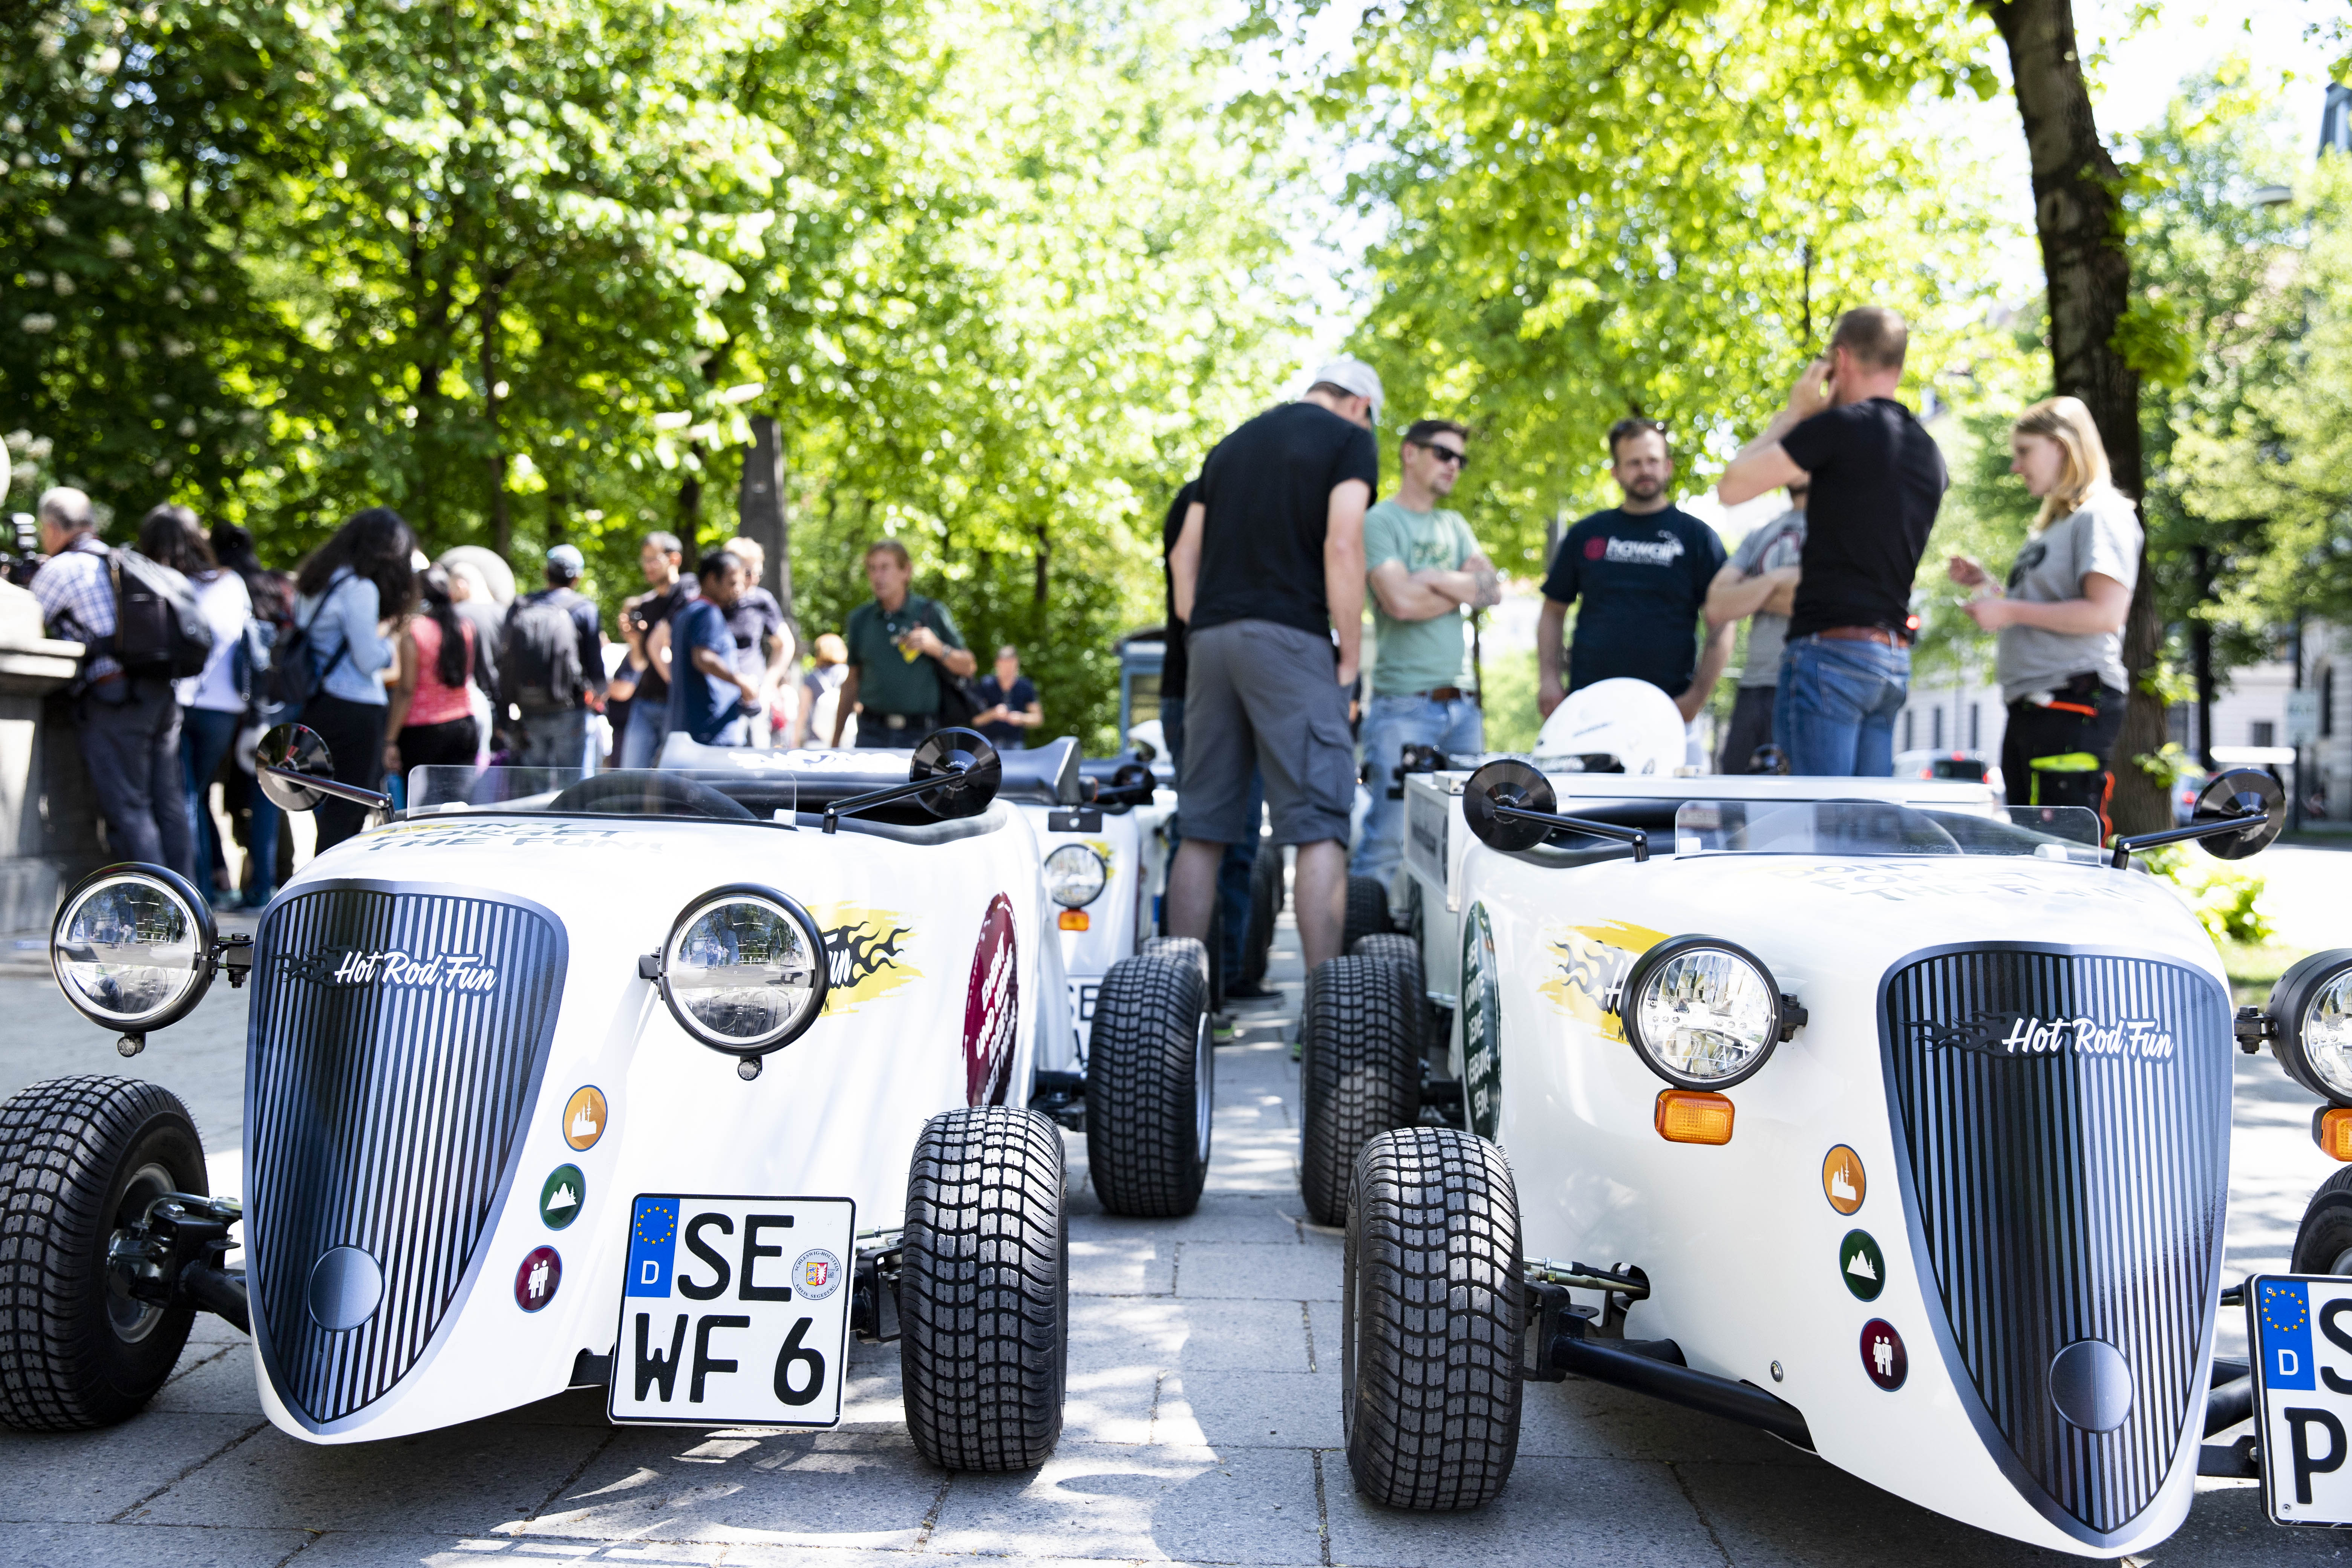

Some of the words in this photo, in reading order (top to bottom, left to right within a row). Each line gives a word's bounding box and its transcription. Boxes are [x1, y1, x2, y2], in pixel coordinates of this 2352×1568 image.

[363, 838, 491, 851] THE
[513, 838, 665, 854] FUN!
[372, 830, 635, 842] FORGET
[334, 951, 383, 983] Hot
[382, 952, 443, 985] Rod
[445, 956, 498, 991] Fun
[824, 933, 853, 985] un
[982, 931, 1005, 1011] EVENT
[1467, 938, 1479, 972] HIER
[1468, 1009, 1484, 1047] DEINE
[2001, 1018, 2071, 1053] Hot
[2072, 1018, 2124, 1054] Rod
[2126, 1021, 2173, 1058] Fun
[641, 1260, 659, 1284] D
[678, 1213, 794, 1302] SE
[795, 1251, 839, 1271] SCHLESWIG-HOLSTEIN
[796, 1284, 808, 1296] KREIS
[810, 1284, 836, 1298] SEGEBERG
[635, 1313, 750, 1403] WF
[774, 1317, 825, 1406] 6
[2278, 1349, 2298, 1375] D
[2284, 1407, 2347, 1504] P
